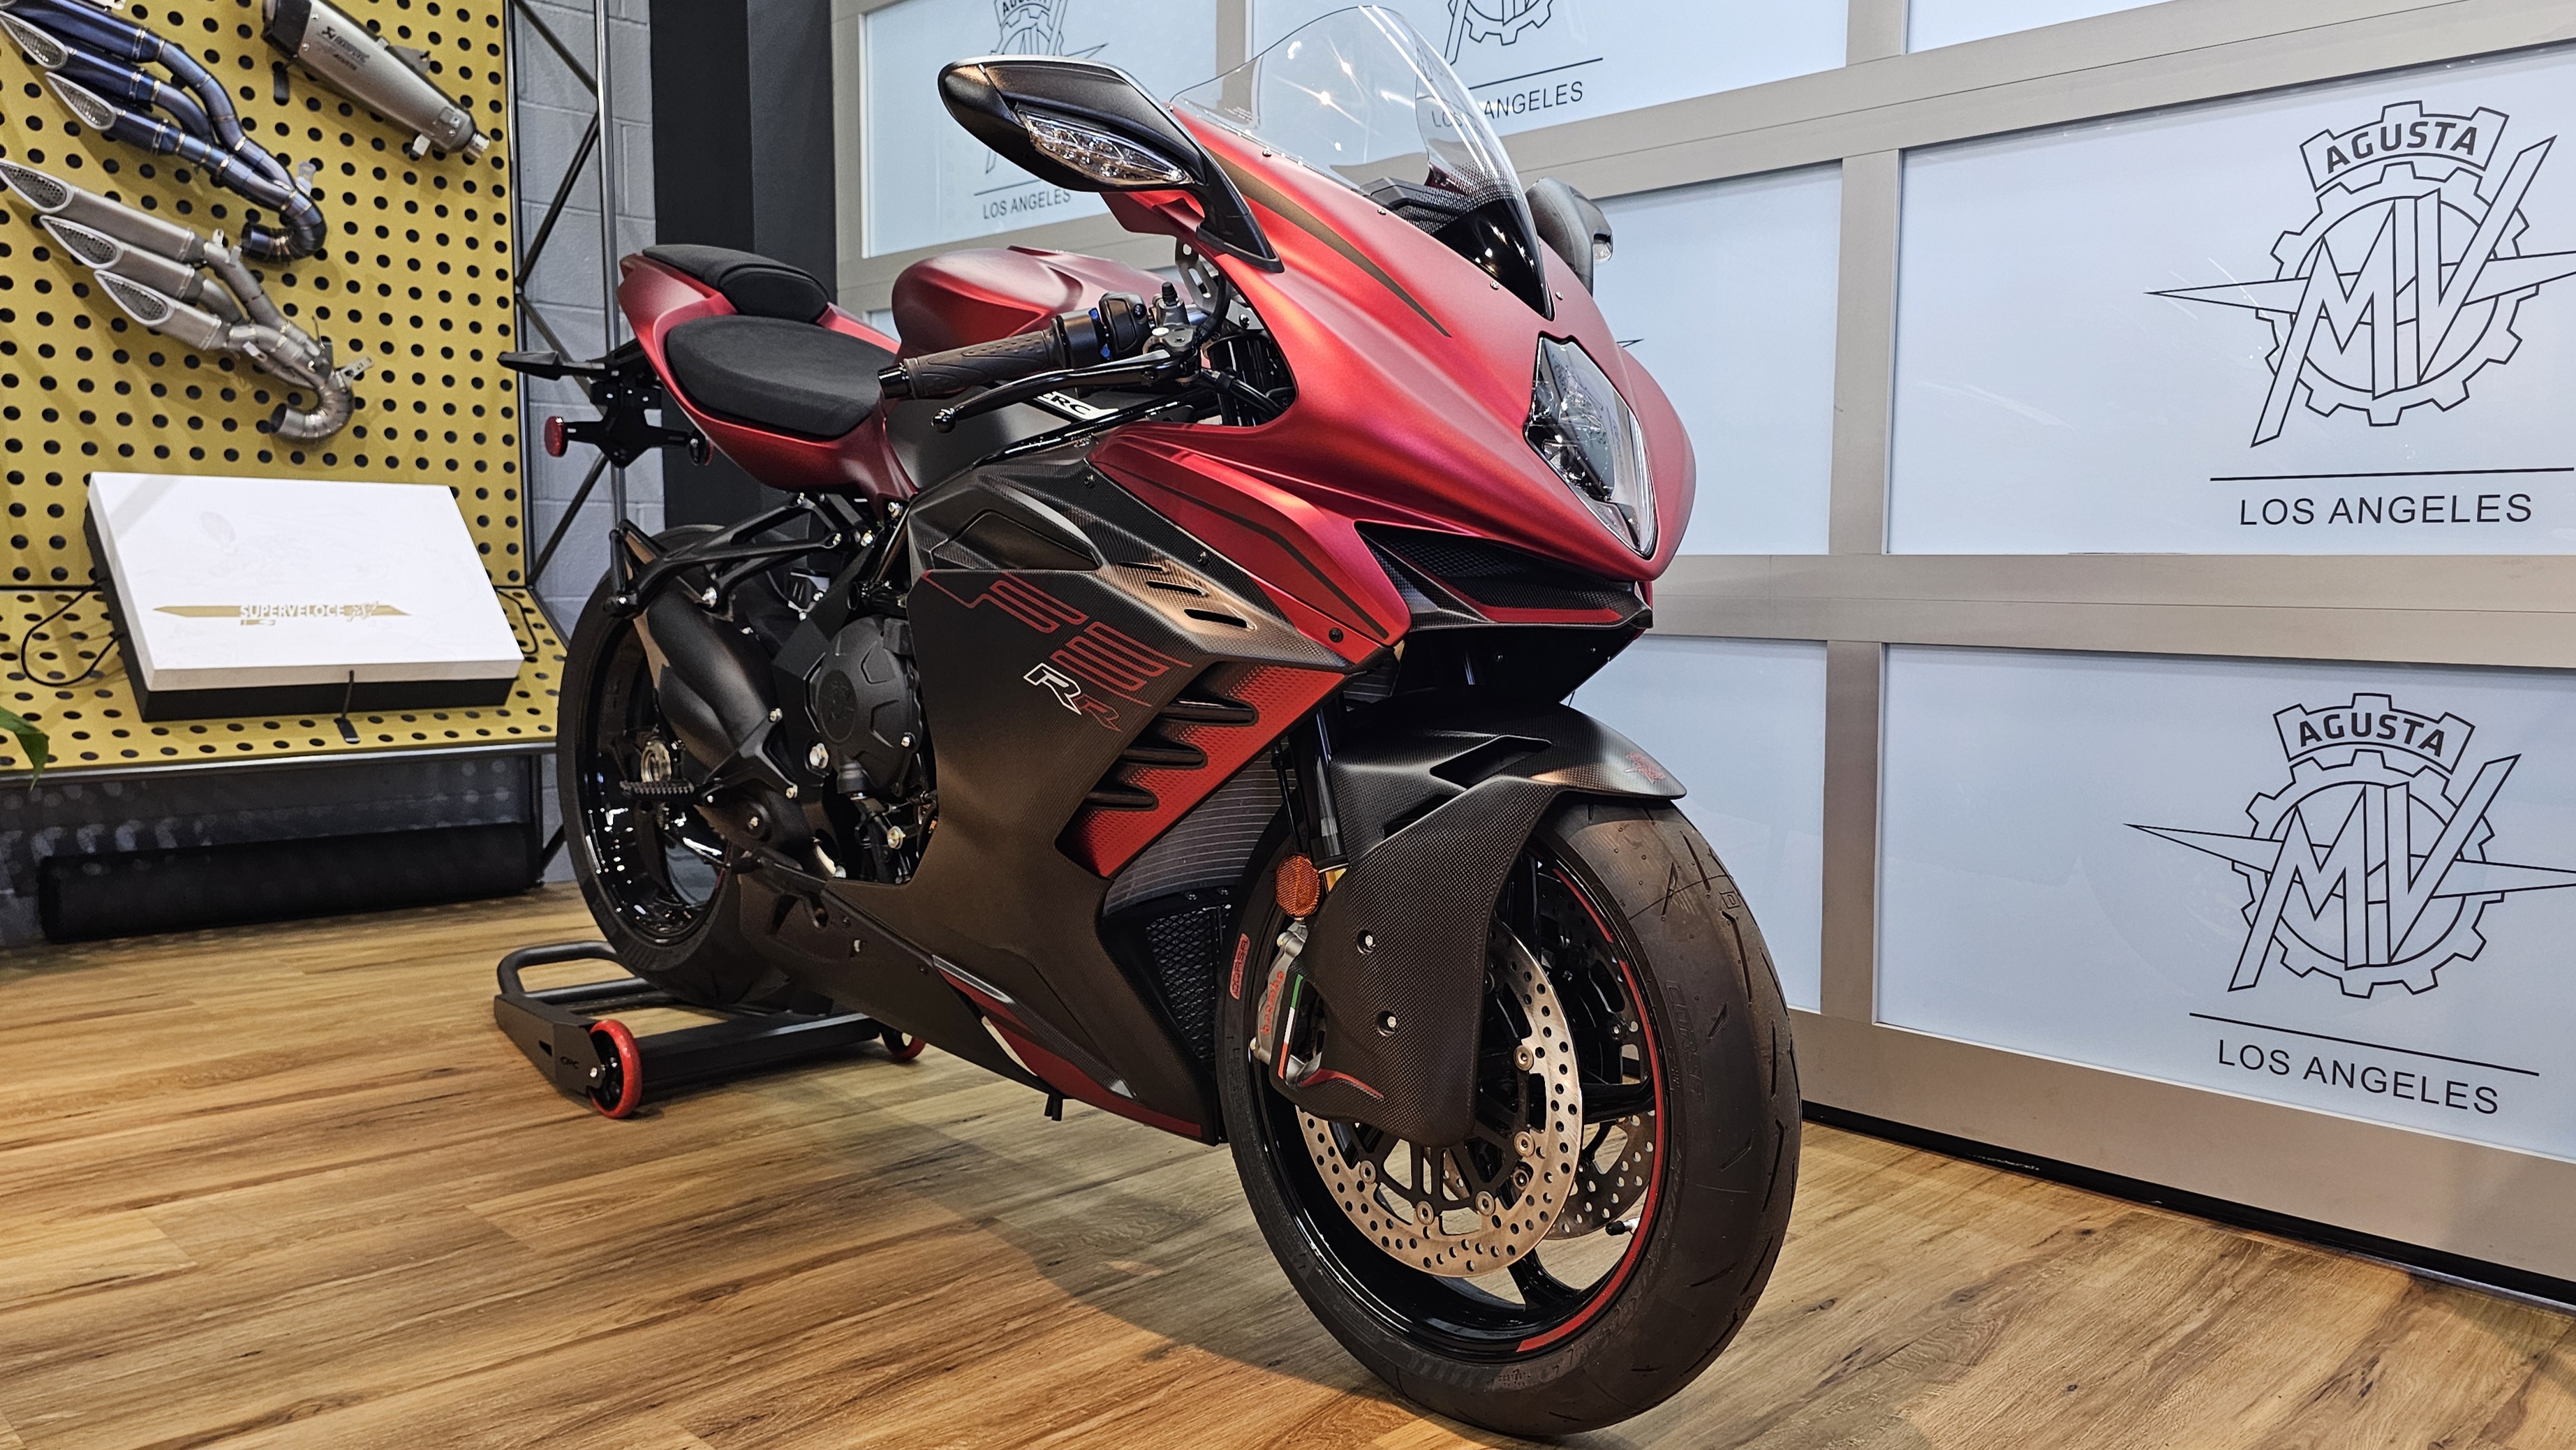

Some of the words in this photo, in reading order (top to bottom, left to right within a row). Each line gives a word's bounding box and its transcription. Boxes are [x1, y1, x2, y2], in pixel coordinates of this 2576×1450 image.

[1483, 81, 1583, 119] ANGELES
[2326, 121, 2478, 174] AGUSTA
[982, 203, 1007, 220] LOS
[1012, 190, 1072, 212] ANGELES
[2240, 497, 2315, 526] LOS
[2328, 493, 2533, 525] ANGELES
[239, 604, 345, 618] SUPERVELOCE
[2298, 711, 2445, 757] AGUSTA
[1259, 970, 1285, 1035] brembo
[2218, 1039, 2291, 1076] LOS
[2302, 1056, 2499, 1115] ANGELES
